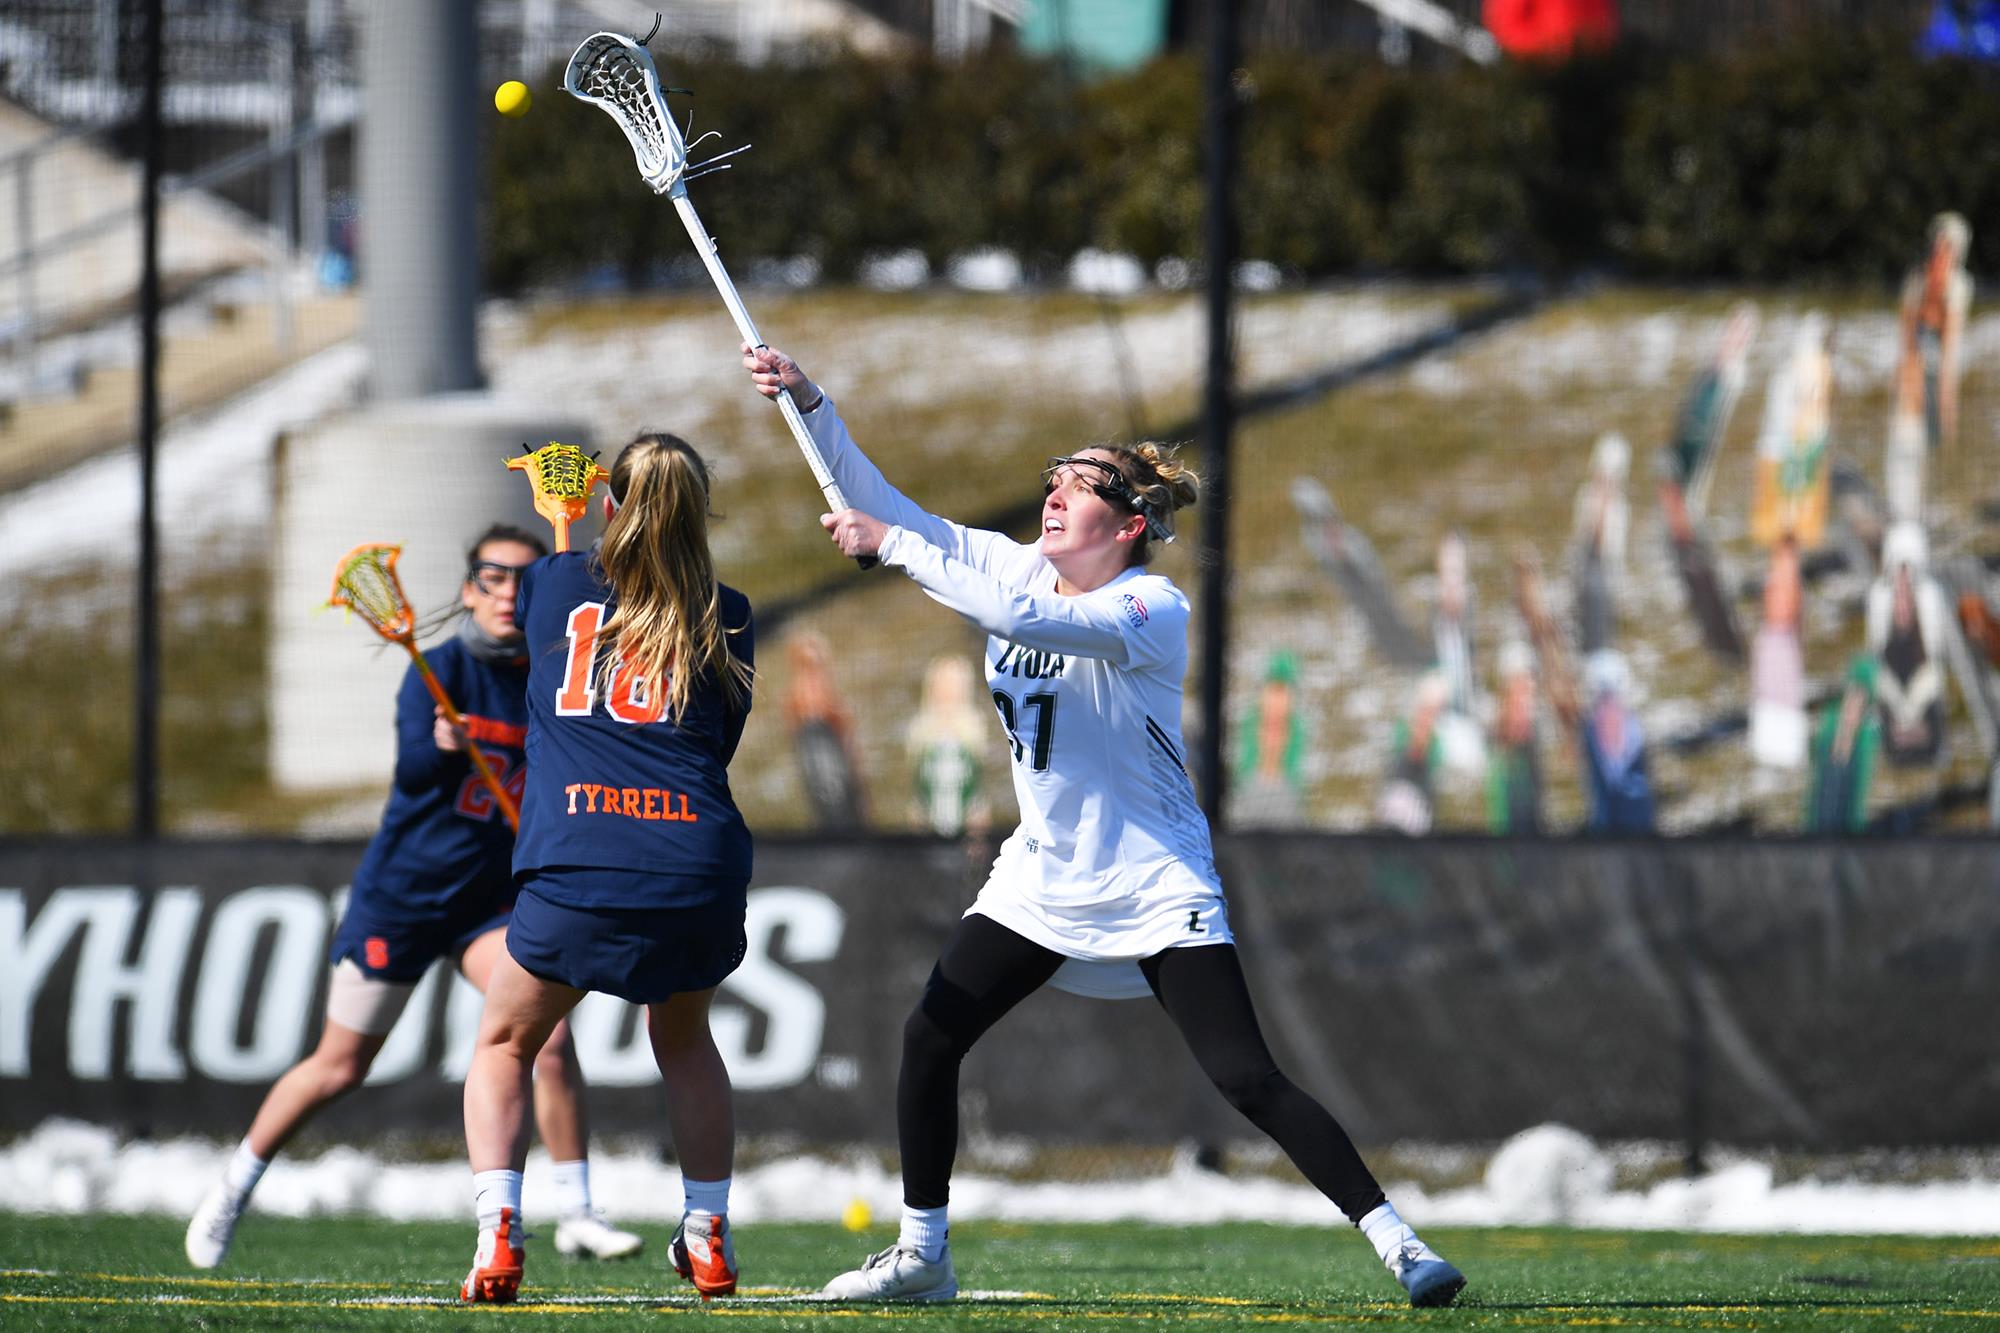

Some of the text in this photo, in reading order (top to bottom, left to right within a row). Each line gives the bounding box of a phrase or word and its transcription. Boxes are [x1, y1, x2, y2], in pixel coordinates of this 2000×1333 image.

[565, 783, 698, 823] TYRRELL
[1188, 910, 1206, 933] L
[0, 885, 844, 1090] YHOS
